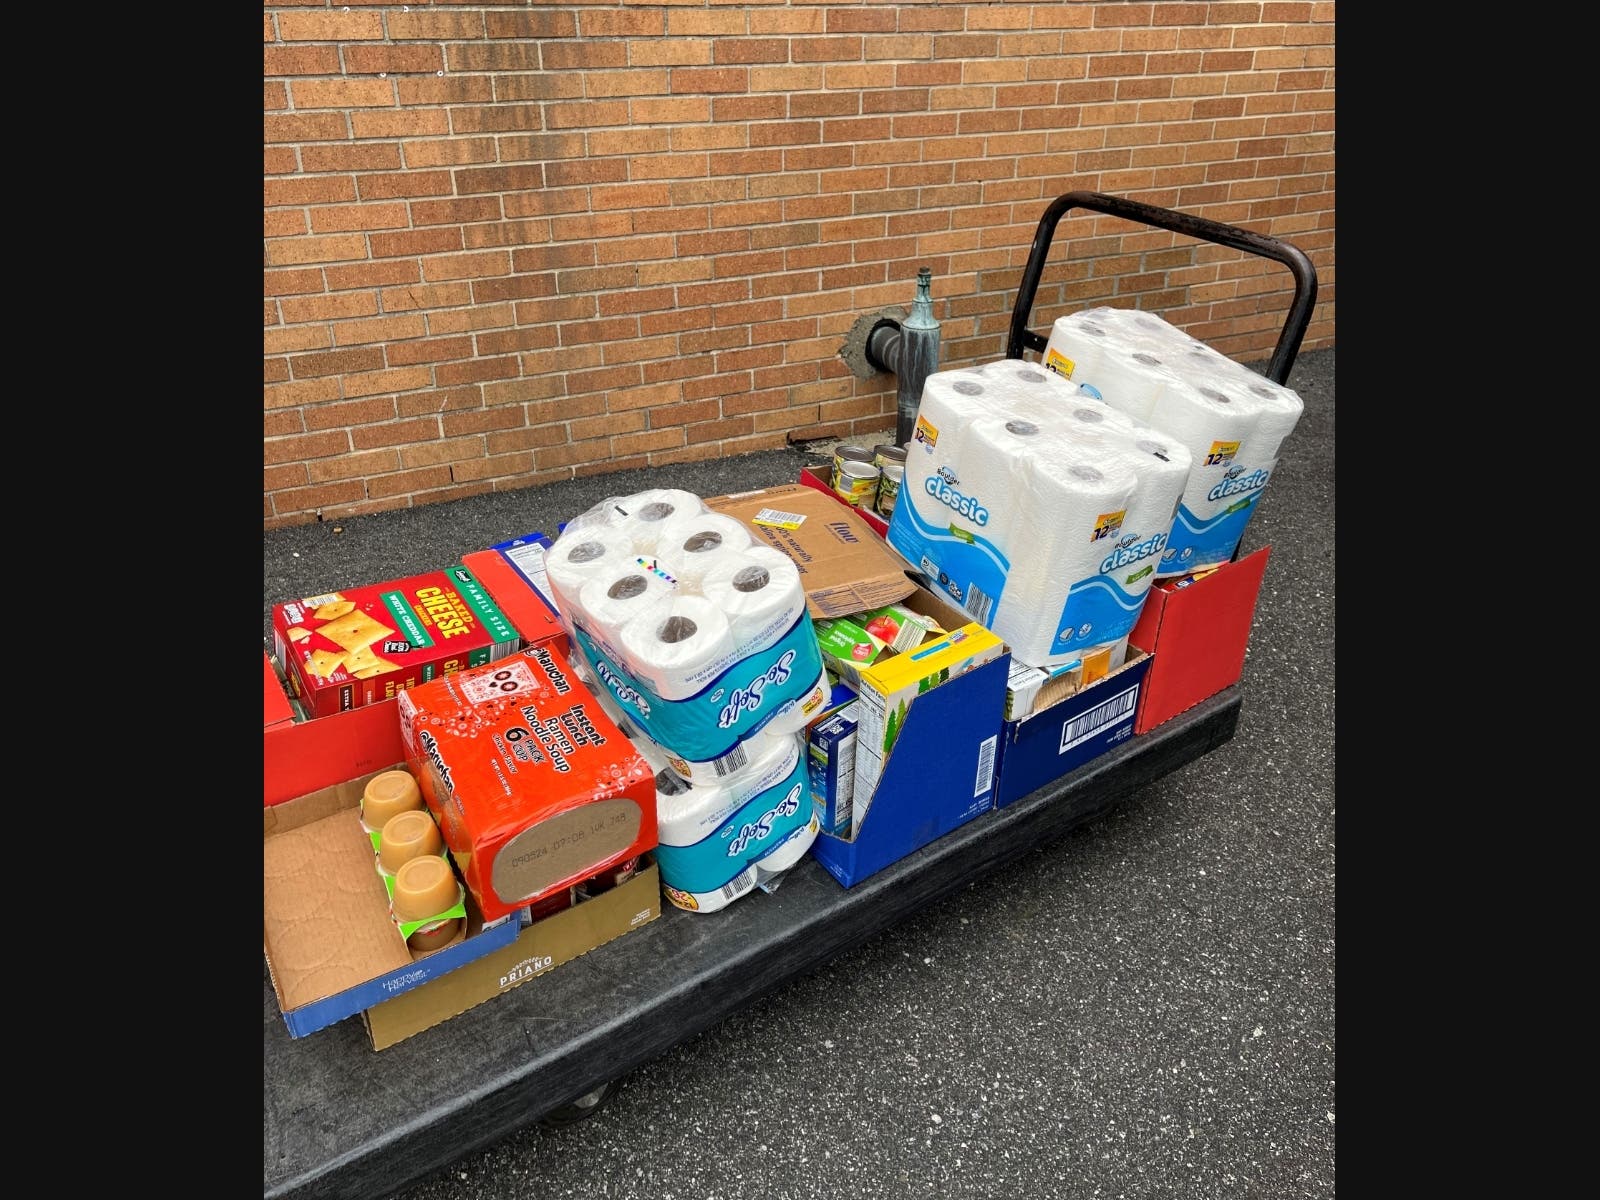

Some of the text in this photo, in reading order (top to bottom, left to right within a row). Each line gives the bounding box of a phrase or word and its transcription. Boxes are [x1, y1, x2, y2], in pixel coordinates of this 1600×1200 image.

[1208, 453, 1223, 465] 12
[925, 476, 989, 526] classic
[1208, 469, 1269, 501] classic
[1094, 526, 1109, 540] 12
[1100, 533, 1168, 575] classic
[388, 594, 409, 616] WHITE
[402, 614, 426, 646] CHEDDAR
[415, 586, 469, 640] CHEESE
[445, 590, 474, 624] BAKED
[467, 583, 510, 638] FAMILY SIZE
[536, 650, 572, 694] Maruchan
[767, 650, 796, 685] So
[717, 676, 766, 728] Soft
[506, 727, 528, 742] 6
[521, 705, 571, 773] Noodle Soup
[546, 718, 575, 754] Ramen
[560, 712, 590, 746] Lunch
[570, 704, 607, 746] Instant
[425, 737, 455, 792] Maruchan
[512, 742, 528, 762] CUP
[527, 739, 547, 764] PACK
[776, 783, 802, 816] So
[728, 811, 775, 857] Soft
[500, 956, 553, 987] PRIANO
